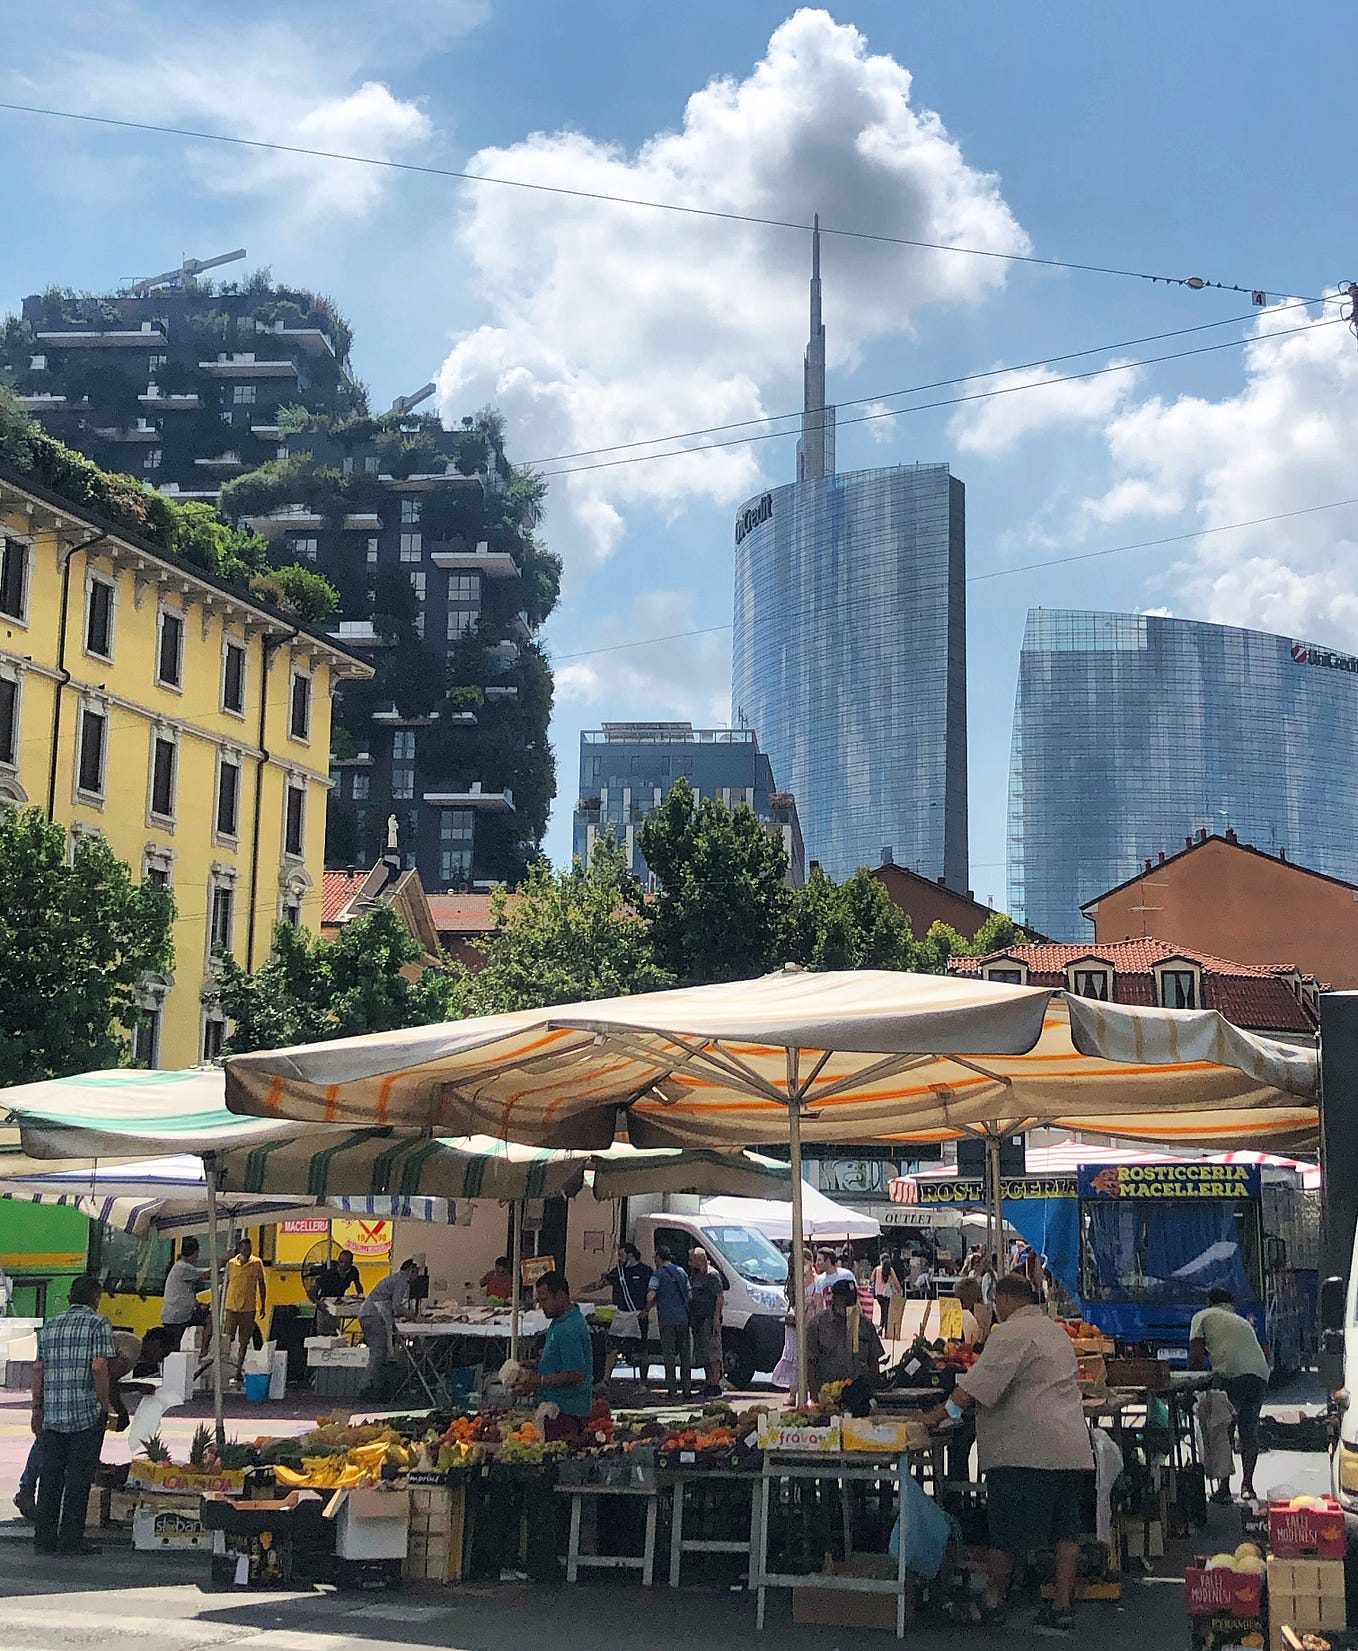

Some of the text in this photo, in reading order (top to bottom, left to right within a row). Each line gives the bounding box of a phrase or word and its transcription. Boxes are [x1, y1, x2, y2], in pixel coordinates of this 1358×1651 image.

[1256, 294, 1263, 305] 4
[1117, 1166, 1249, 1181] ROSTICCERIA
[920, 1179, 1078, 1203] ROSTCCERIA
[1118, 1182, 1249, 1197] MACELLERIA
[284, 1220, 328, 1232] MACELLERIA
[885, 1213, 932, 1225] OUTLET
[1286, 1513, 1309, 1530] VALLI
